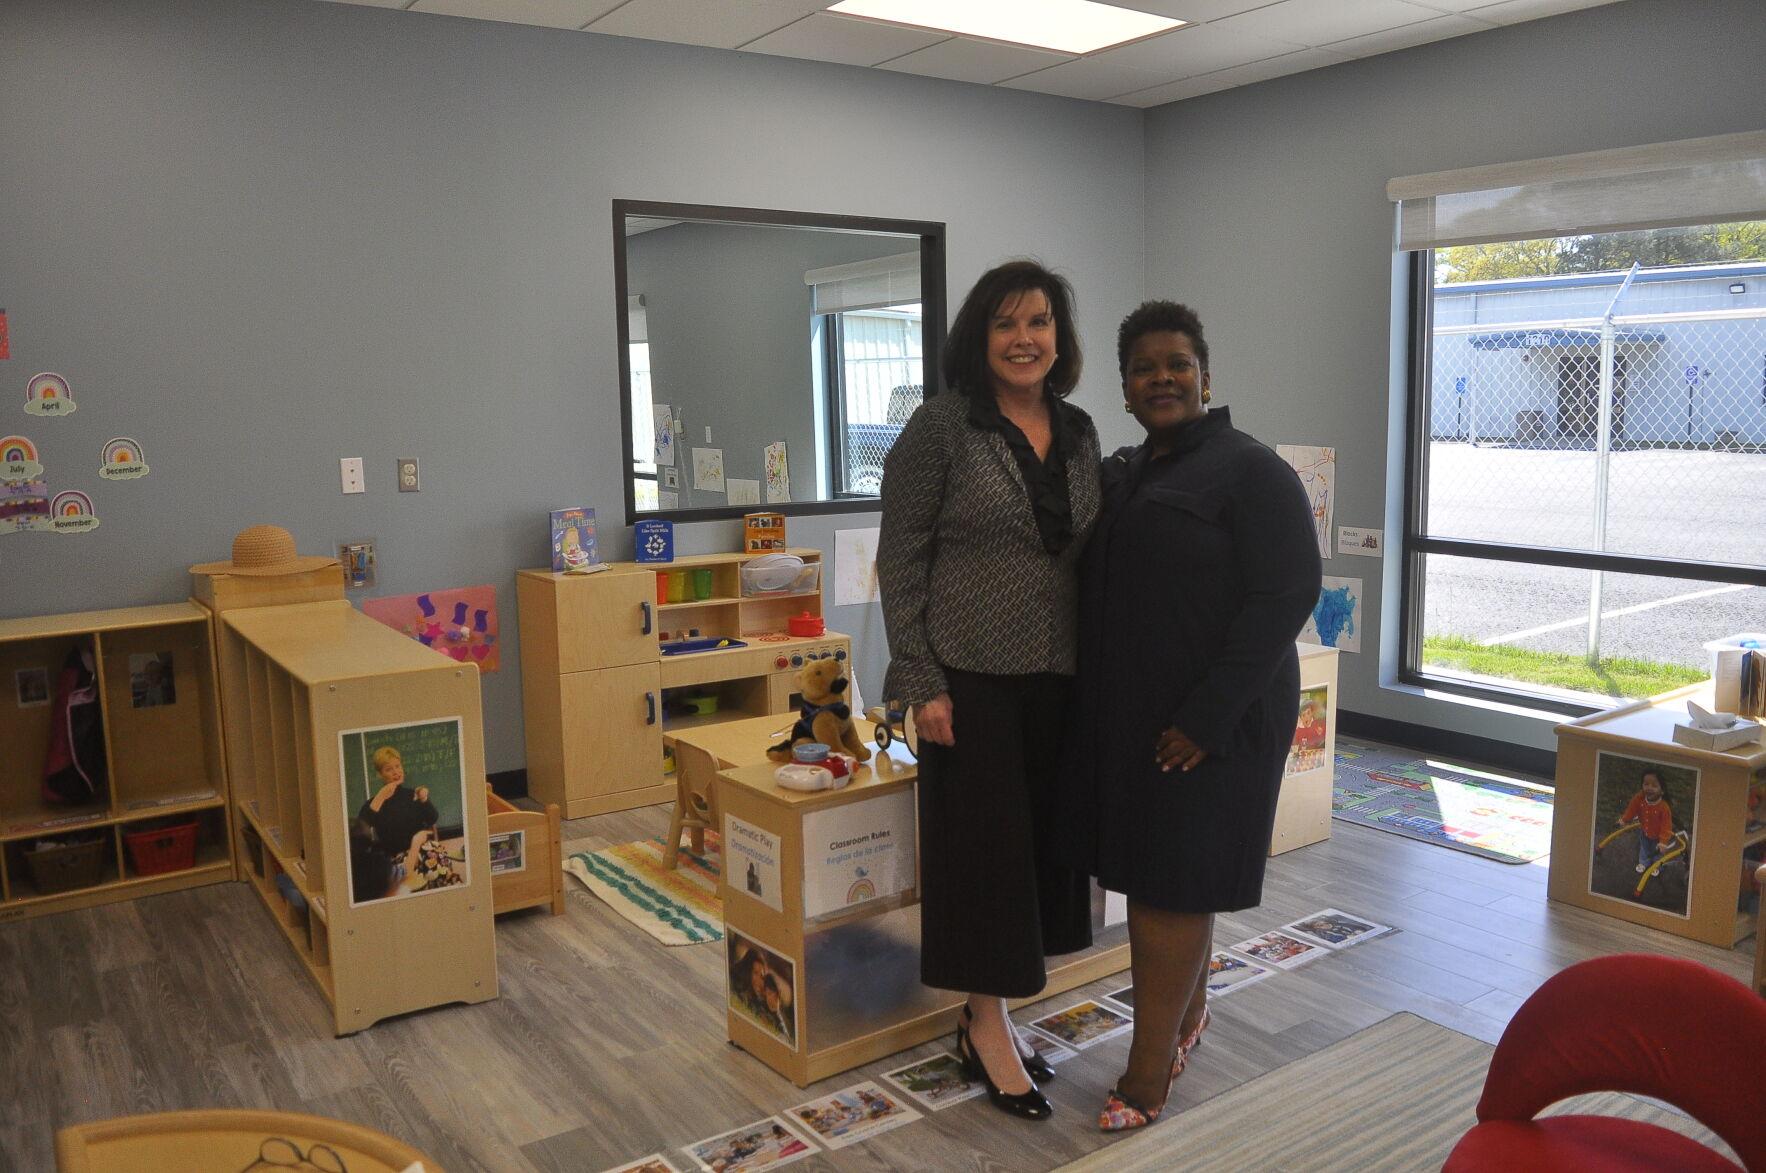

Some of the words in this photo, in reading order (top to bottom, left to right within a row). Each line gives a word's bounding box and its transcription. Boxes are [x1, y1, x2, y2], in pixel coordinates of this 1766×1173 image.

[41, 402, 60, 411] April
[9, 465, 25, 473] July
[106, 466, 142, 475] December
[54, 519, 92, 528] November
[731, 821, 760, 842] Dramatic
[760, 833, 773, 850] Play
[829, 835, 870, 851] Classroom
[871, 830, 890, 840] Rules
[826, 853, 851, 865] Reglas
[852, 850, 863, 858] de
